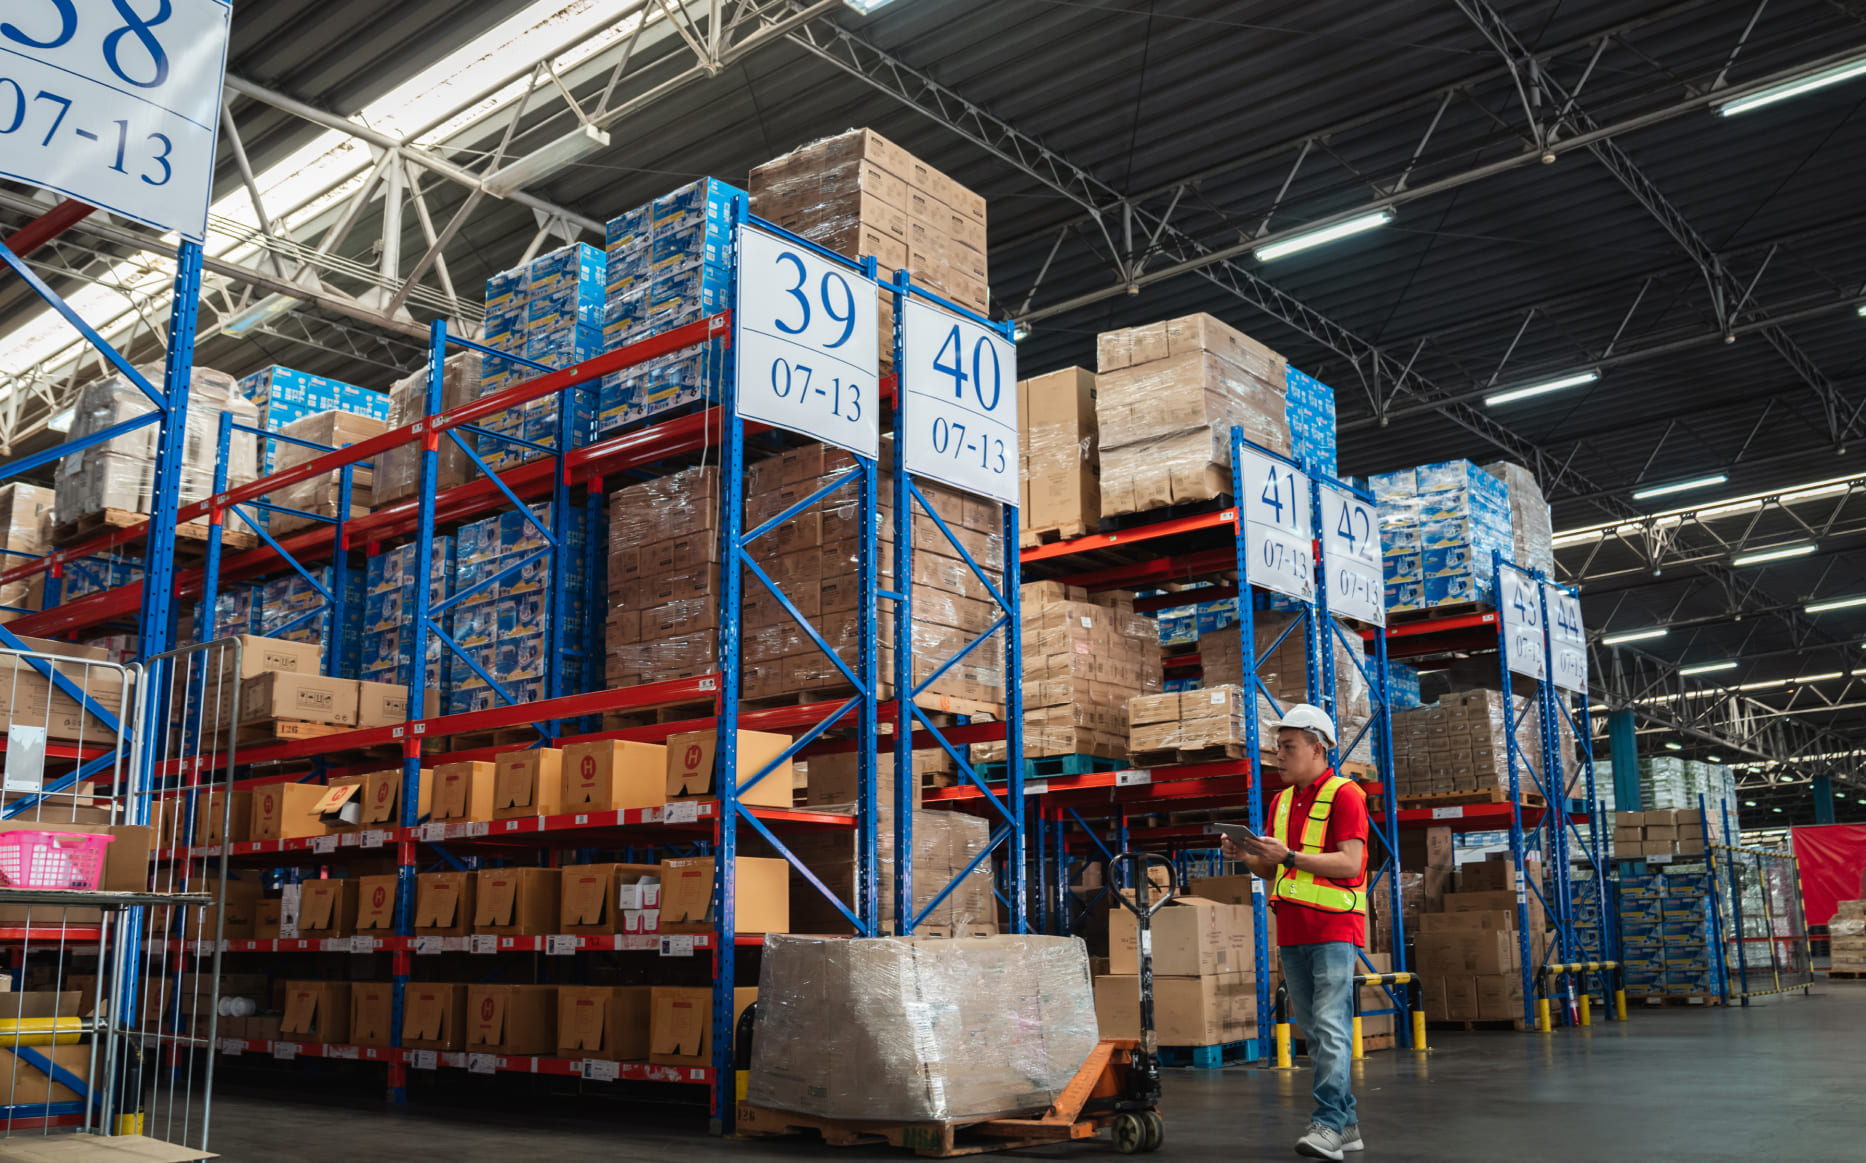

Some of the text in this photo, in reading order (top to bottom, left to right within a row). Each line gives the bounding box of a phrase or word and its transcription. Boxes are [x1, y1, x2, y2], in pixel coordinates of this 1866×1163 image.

[0, 78, 173, 186] 07-13
[774, 251, 856, 349] 39
[771, 357, 861, 423] 07-13
[932, 324, 1001, 412] 40
[932, 416, 1006, 474] 07-13
[1261, 464, 1299, 532] 41
[1263, 539, 1307, 580] 07-13
[1337, 500, 1374, 563] 42
[1340, 568, 1379, 606] 07-13
[1558, 598, 1579, 643] 44
